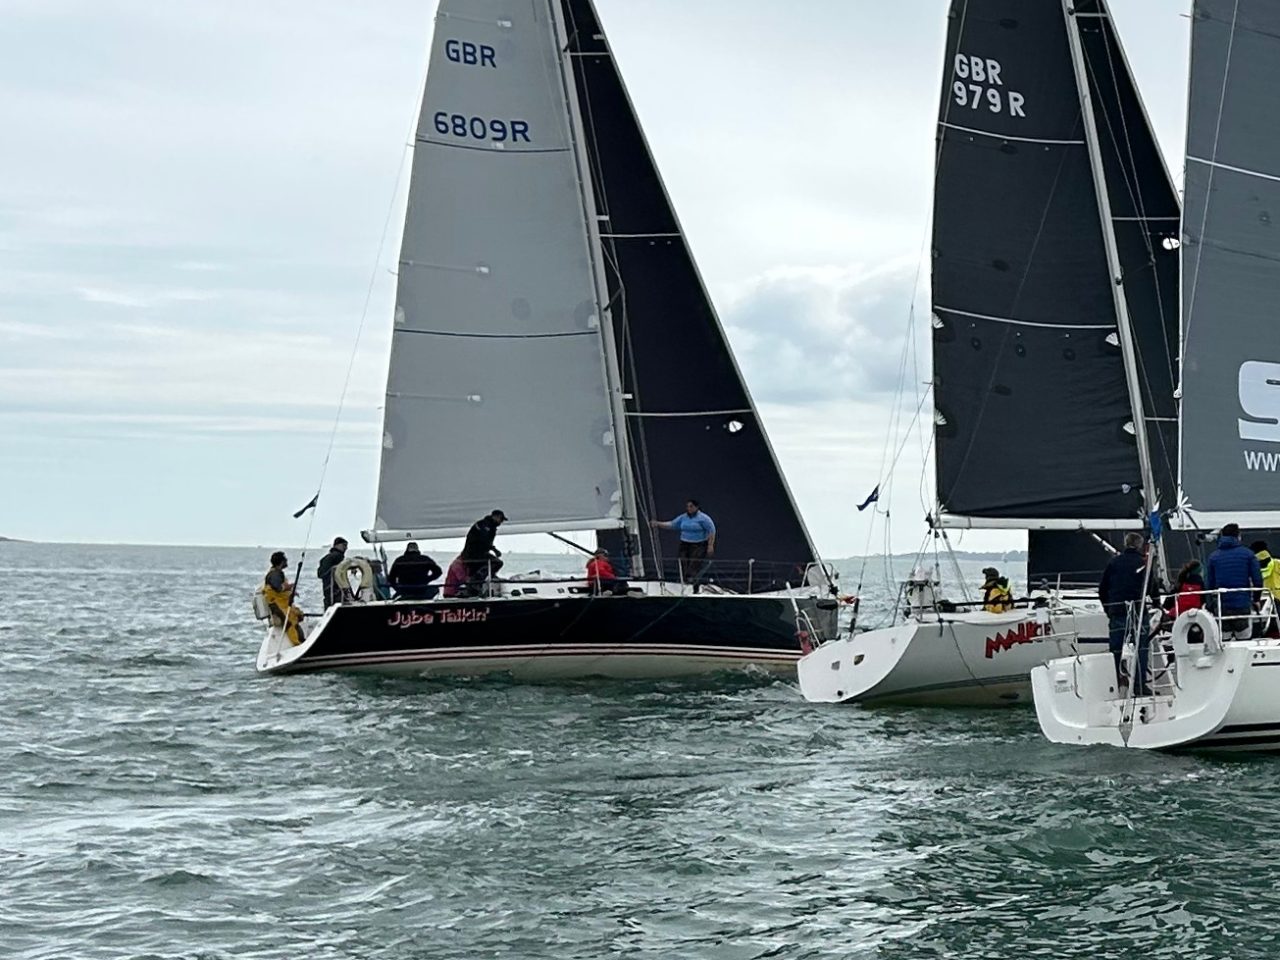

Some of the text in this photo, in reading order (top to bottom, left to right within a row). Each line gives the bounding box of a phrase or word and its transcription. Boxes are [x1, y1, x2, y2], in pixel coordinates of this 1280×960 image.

[445, 39, 497, 68] GBR
[954, 53, 1003, 85] GBR
[953, 80, 1026, 117] 979 R
[434, 111, 531, 142] 6809R
[388, 610, 434, 628] Jybe
